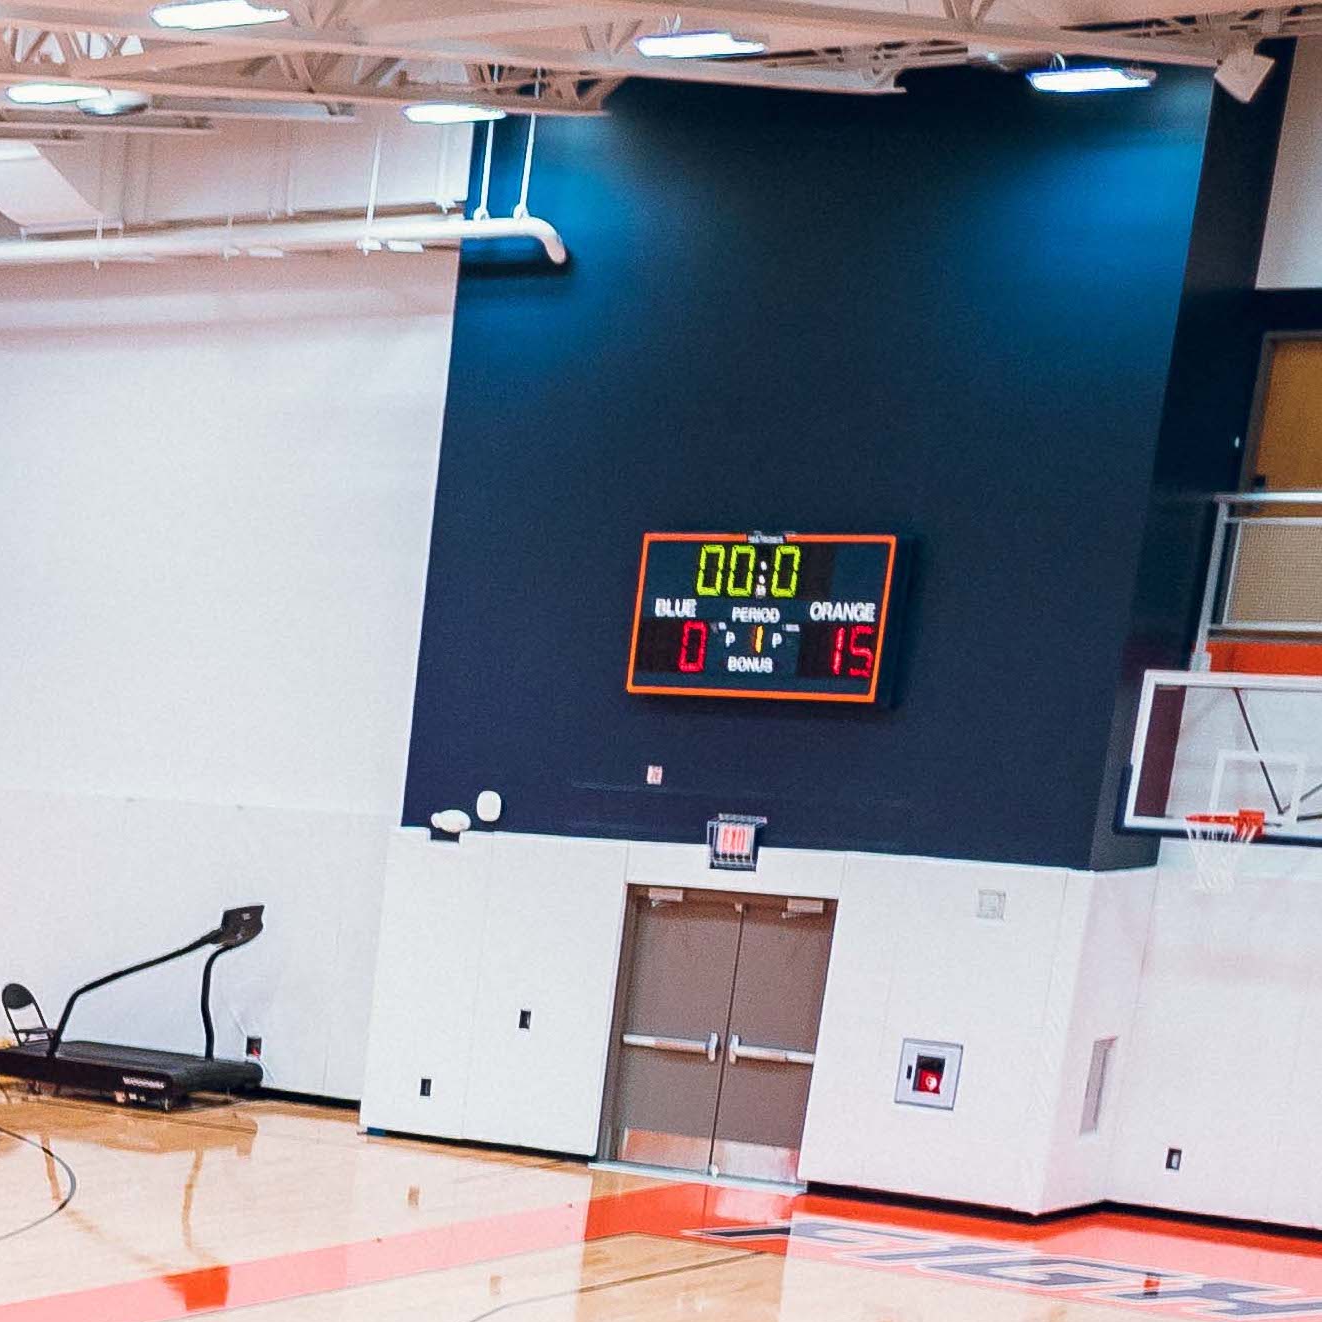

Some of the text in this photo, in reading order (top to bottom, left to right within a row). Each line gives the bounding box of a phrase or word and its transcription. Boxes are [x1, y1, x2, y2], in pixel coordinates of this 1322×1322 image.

[654, 598, 698, 618] BLUE
[731, 606, 781, 624] PERIOD
[809, 601, 877, 623] ORANGE
[678, 620, 709, 673] 0
[754, 625, 765, 653] 1
[829, 625, 875, 677] 15
[727, 656, 773, 674] BONUS
